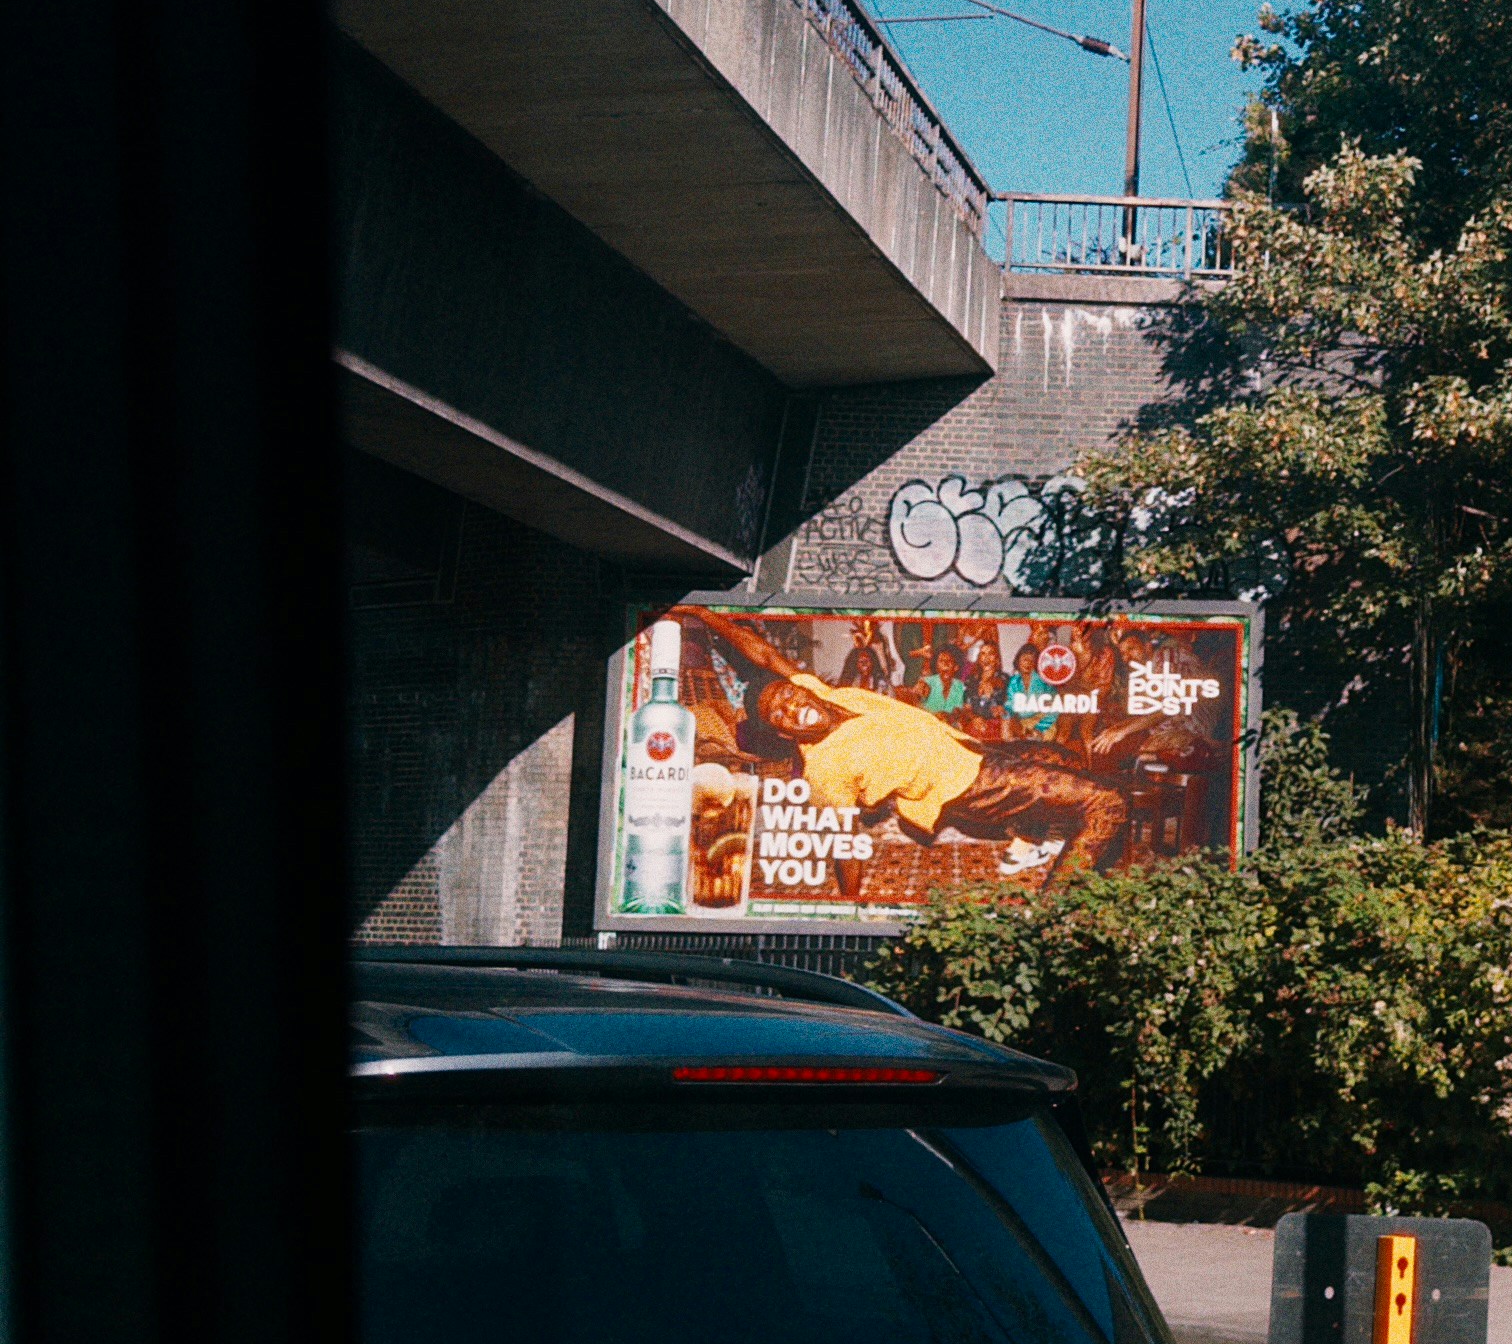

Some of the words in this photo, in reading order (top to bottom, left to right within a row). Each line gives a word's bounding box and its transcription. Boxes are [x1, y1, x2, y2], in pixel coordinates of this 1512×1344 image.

[1127, 679, 1221, 699] POINTS
[762, 778, 812, 804] DO
[760, 806, 861, 832] WHAT
[758, 833, 874, 861] MOVES
[758, 859, 827, 886] YOU
